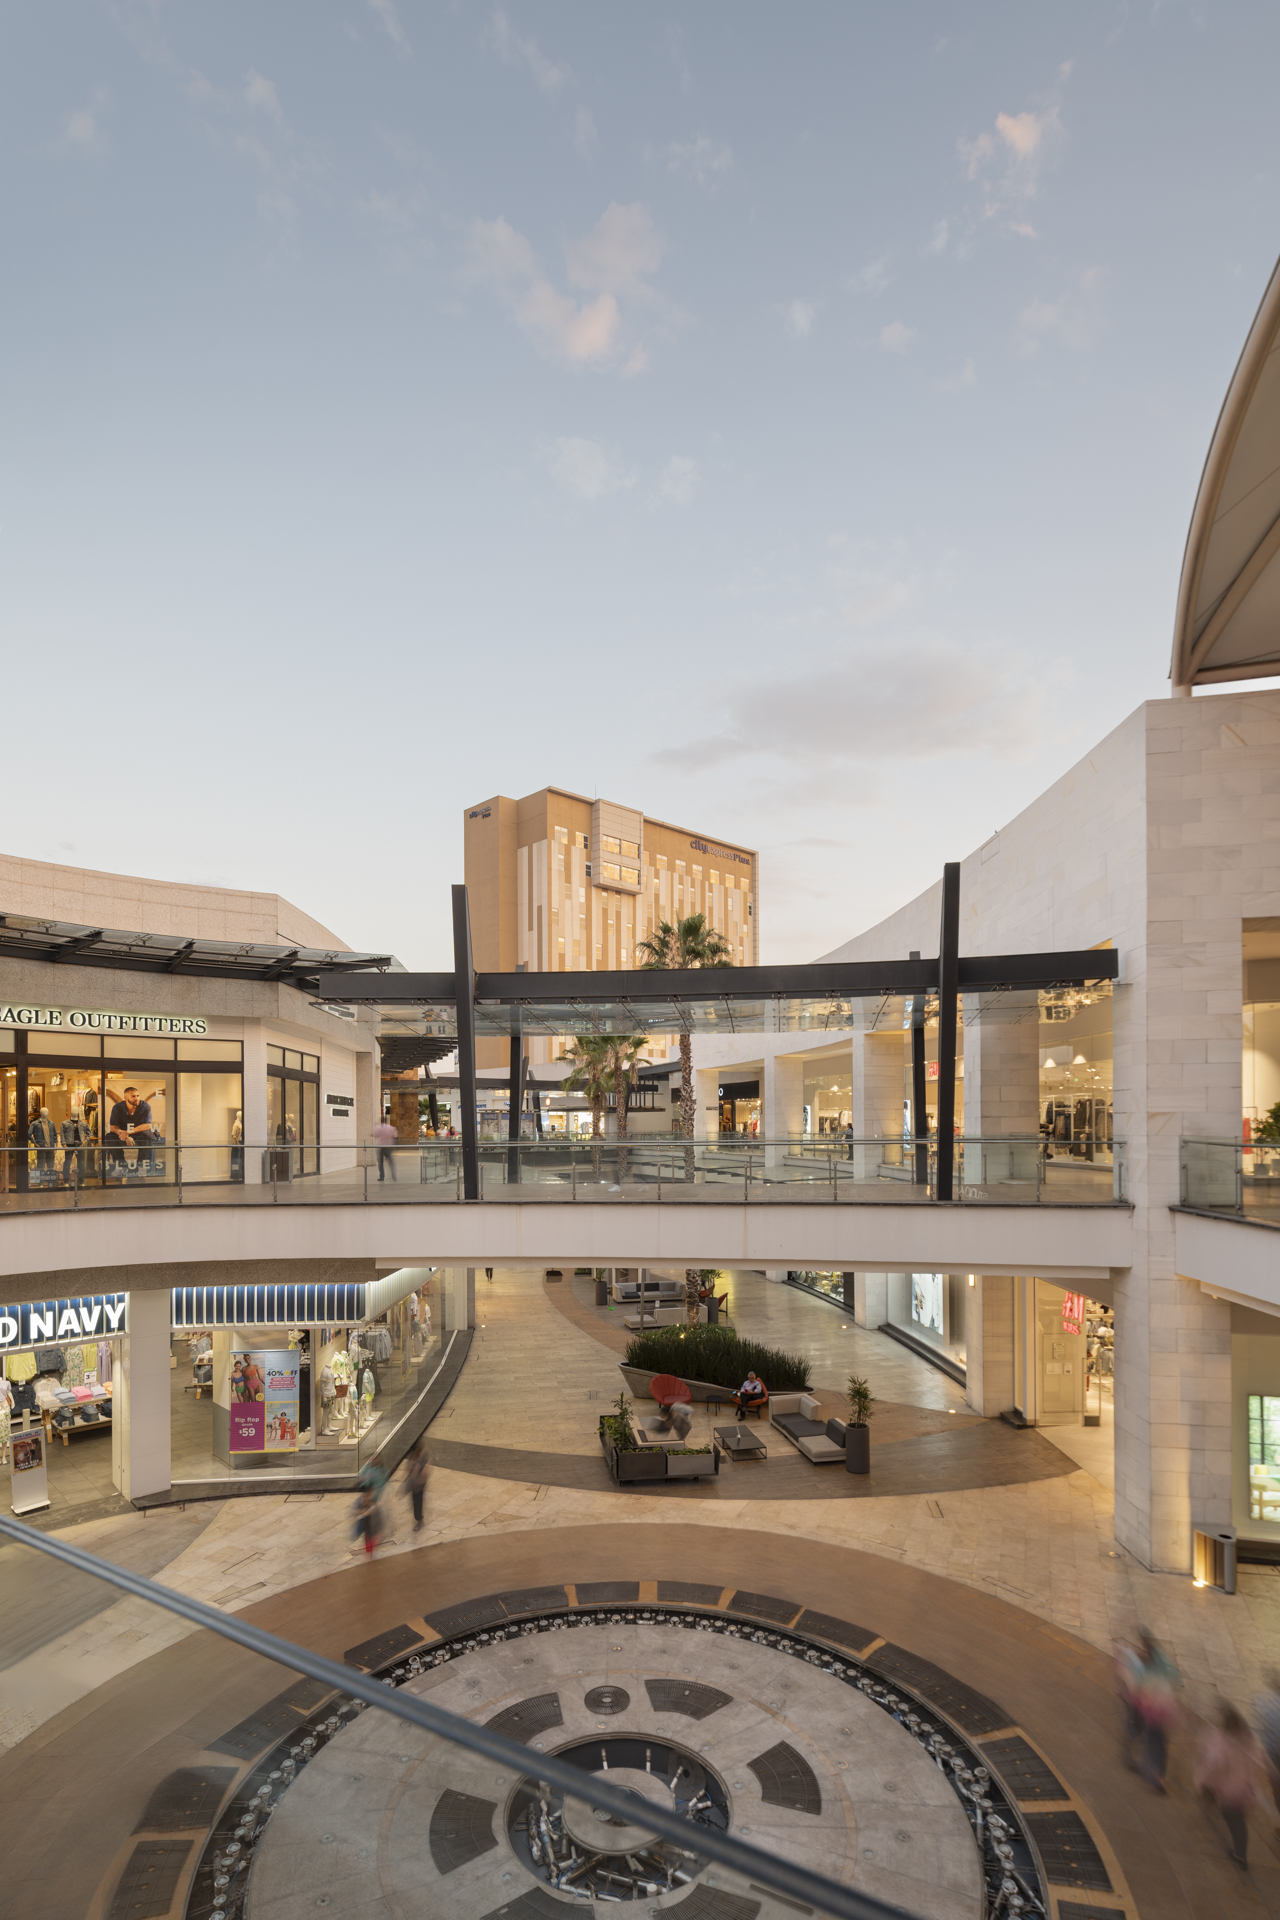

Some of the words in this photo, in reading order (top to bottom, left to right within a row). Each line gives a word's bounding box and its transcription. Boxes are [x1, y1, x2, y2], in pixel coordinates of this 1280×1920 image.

[0, 1007, 62, 1026] AGLE
[69, 1012, 207, 1034] OUTFITTERS
[30, 1303, 125, 1340] NAVY
[239, 1427, 256, 1437] $59
